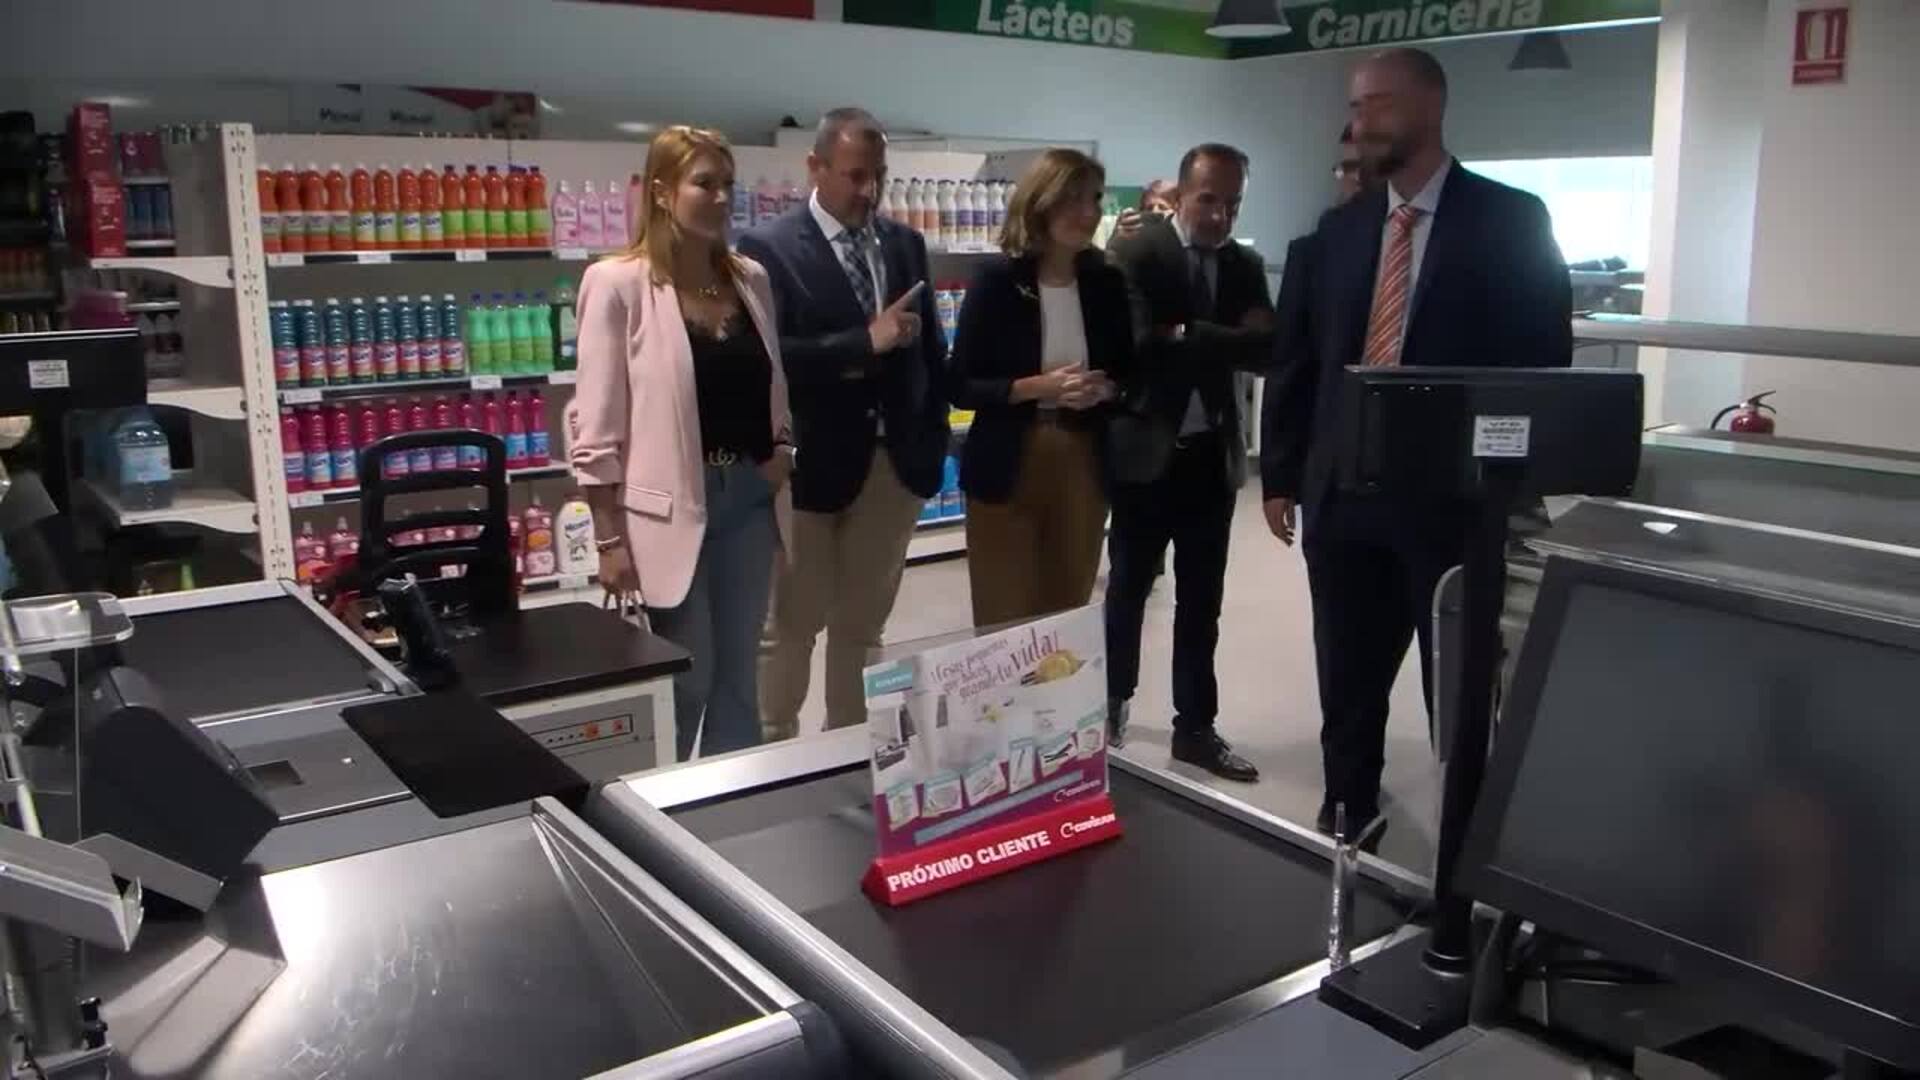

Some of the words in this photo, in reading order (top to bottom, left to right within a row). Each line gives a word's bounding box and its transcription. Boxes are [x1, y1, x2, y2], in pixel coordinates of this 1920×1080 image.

[977, 0, 1135, 46] Lácteos
[887, 854, 974, 892] PRÓXIMO
[976, 830, 1051, 865] CLIENTE
